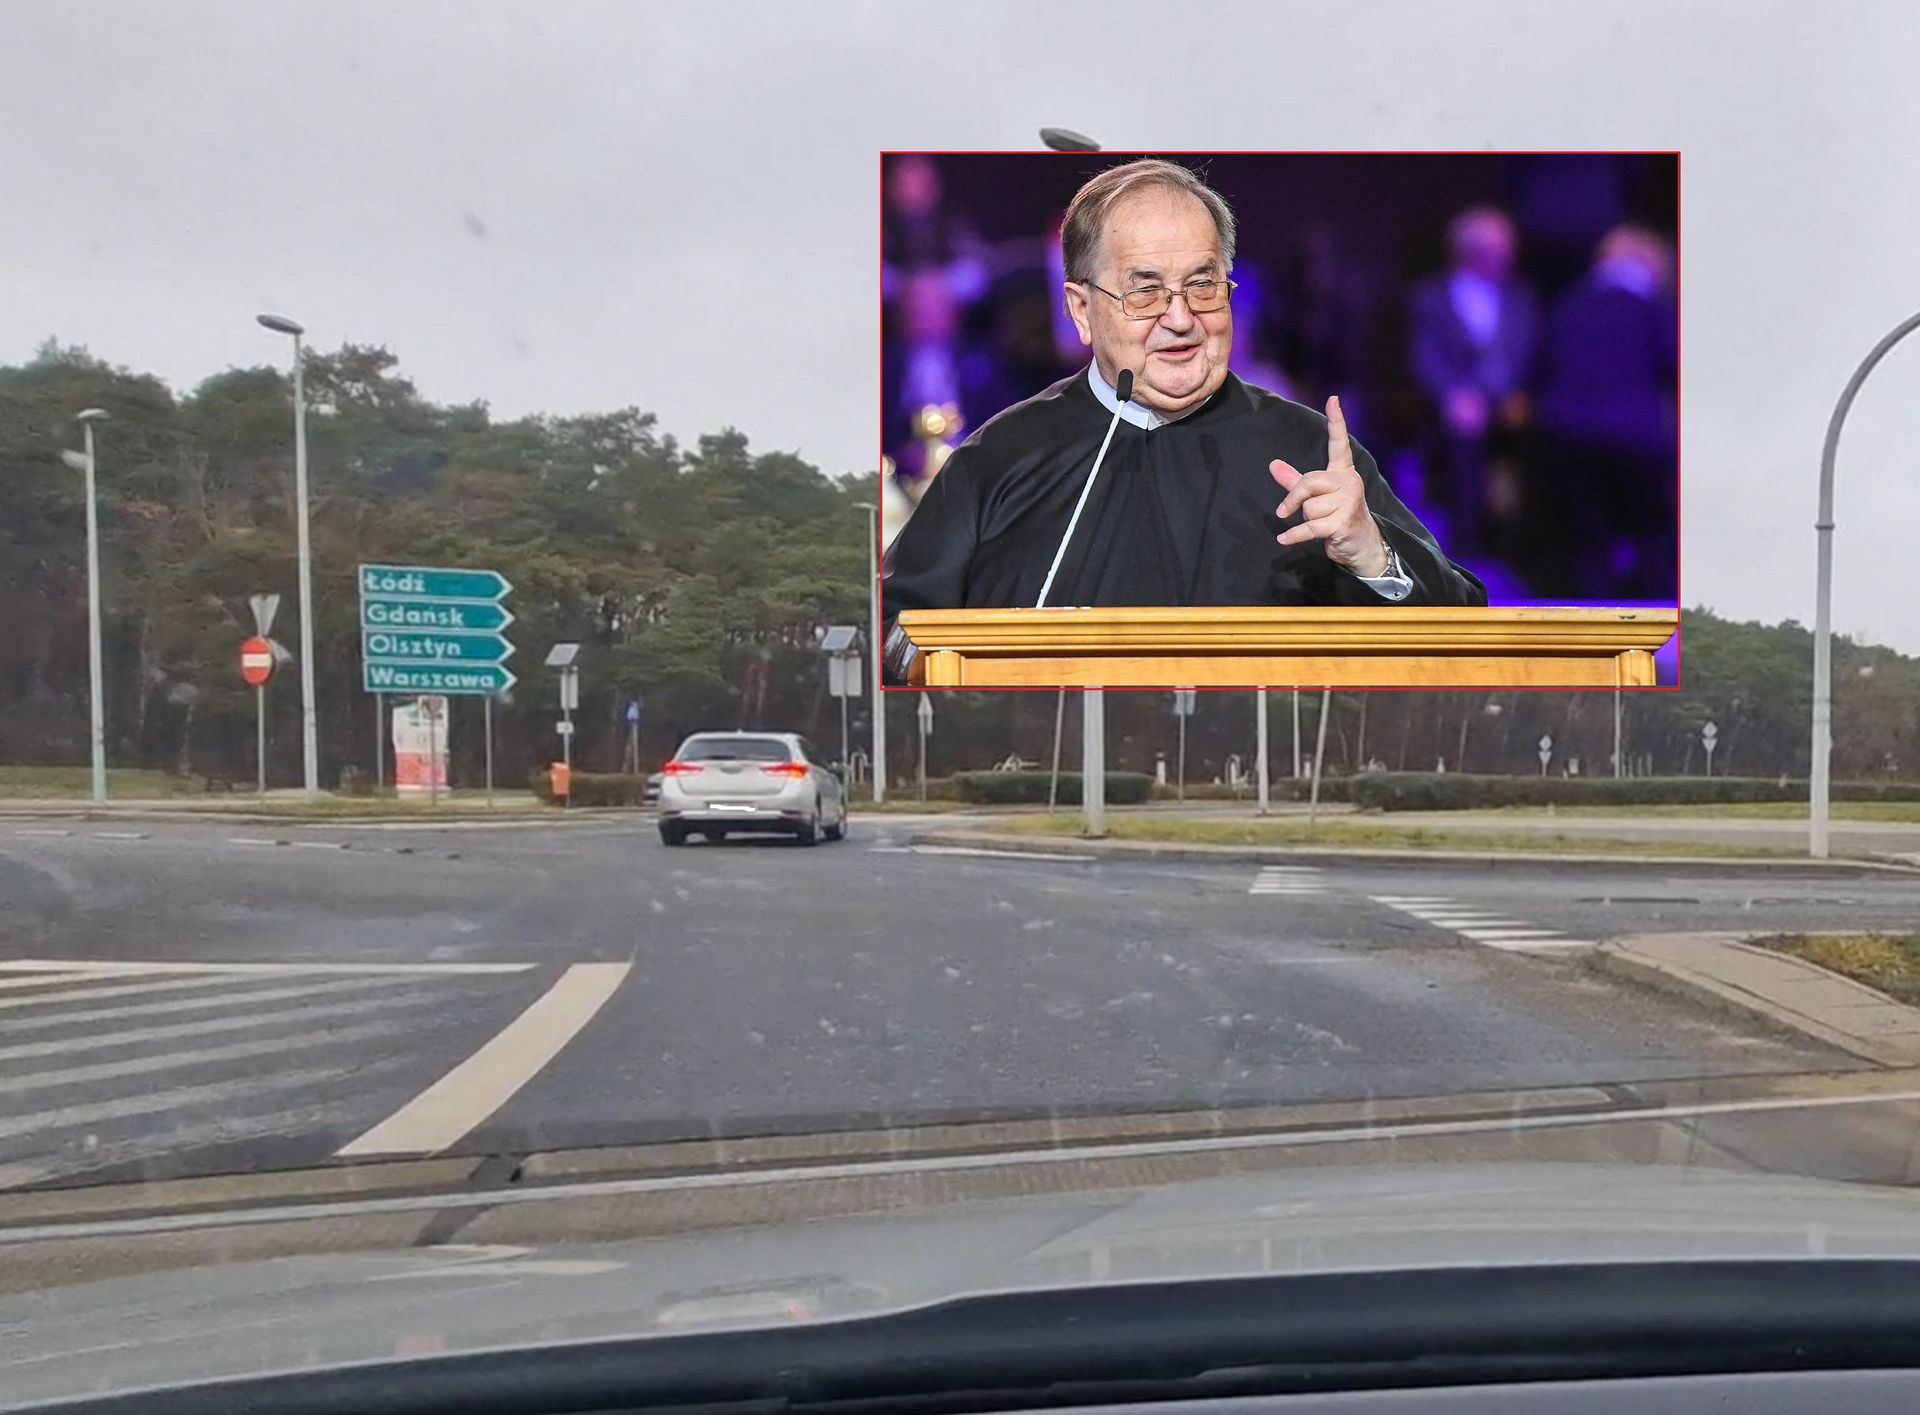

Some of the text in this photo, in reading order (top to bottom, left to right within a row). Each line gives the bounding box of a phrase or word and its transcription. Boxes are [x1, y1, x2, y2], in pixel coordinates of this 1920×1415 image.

[365, 571, 426, 592] Łódź
[367, 603, 464, 626] Gdańsk
[368, 634, 461, 659] Olsztyn
[370, 666, 495, 688] Warszawa
